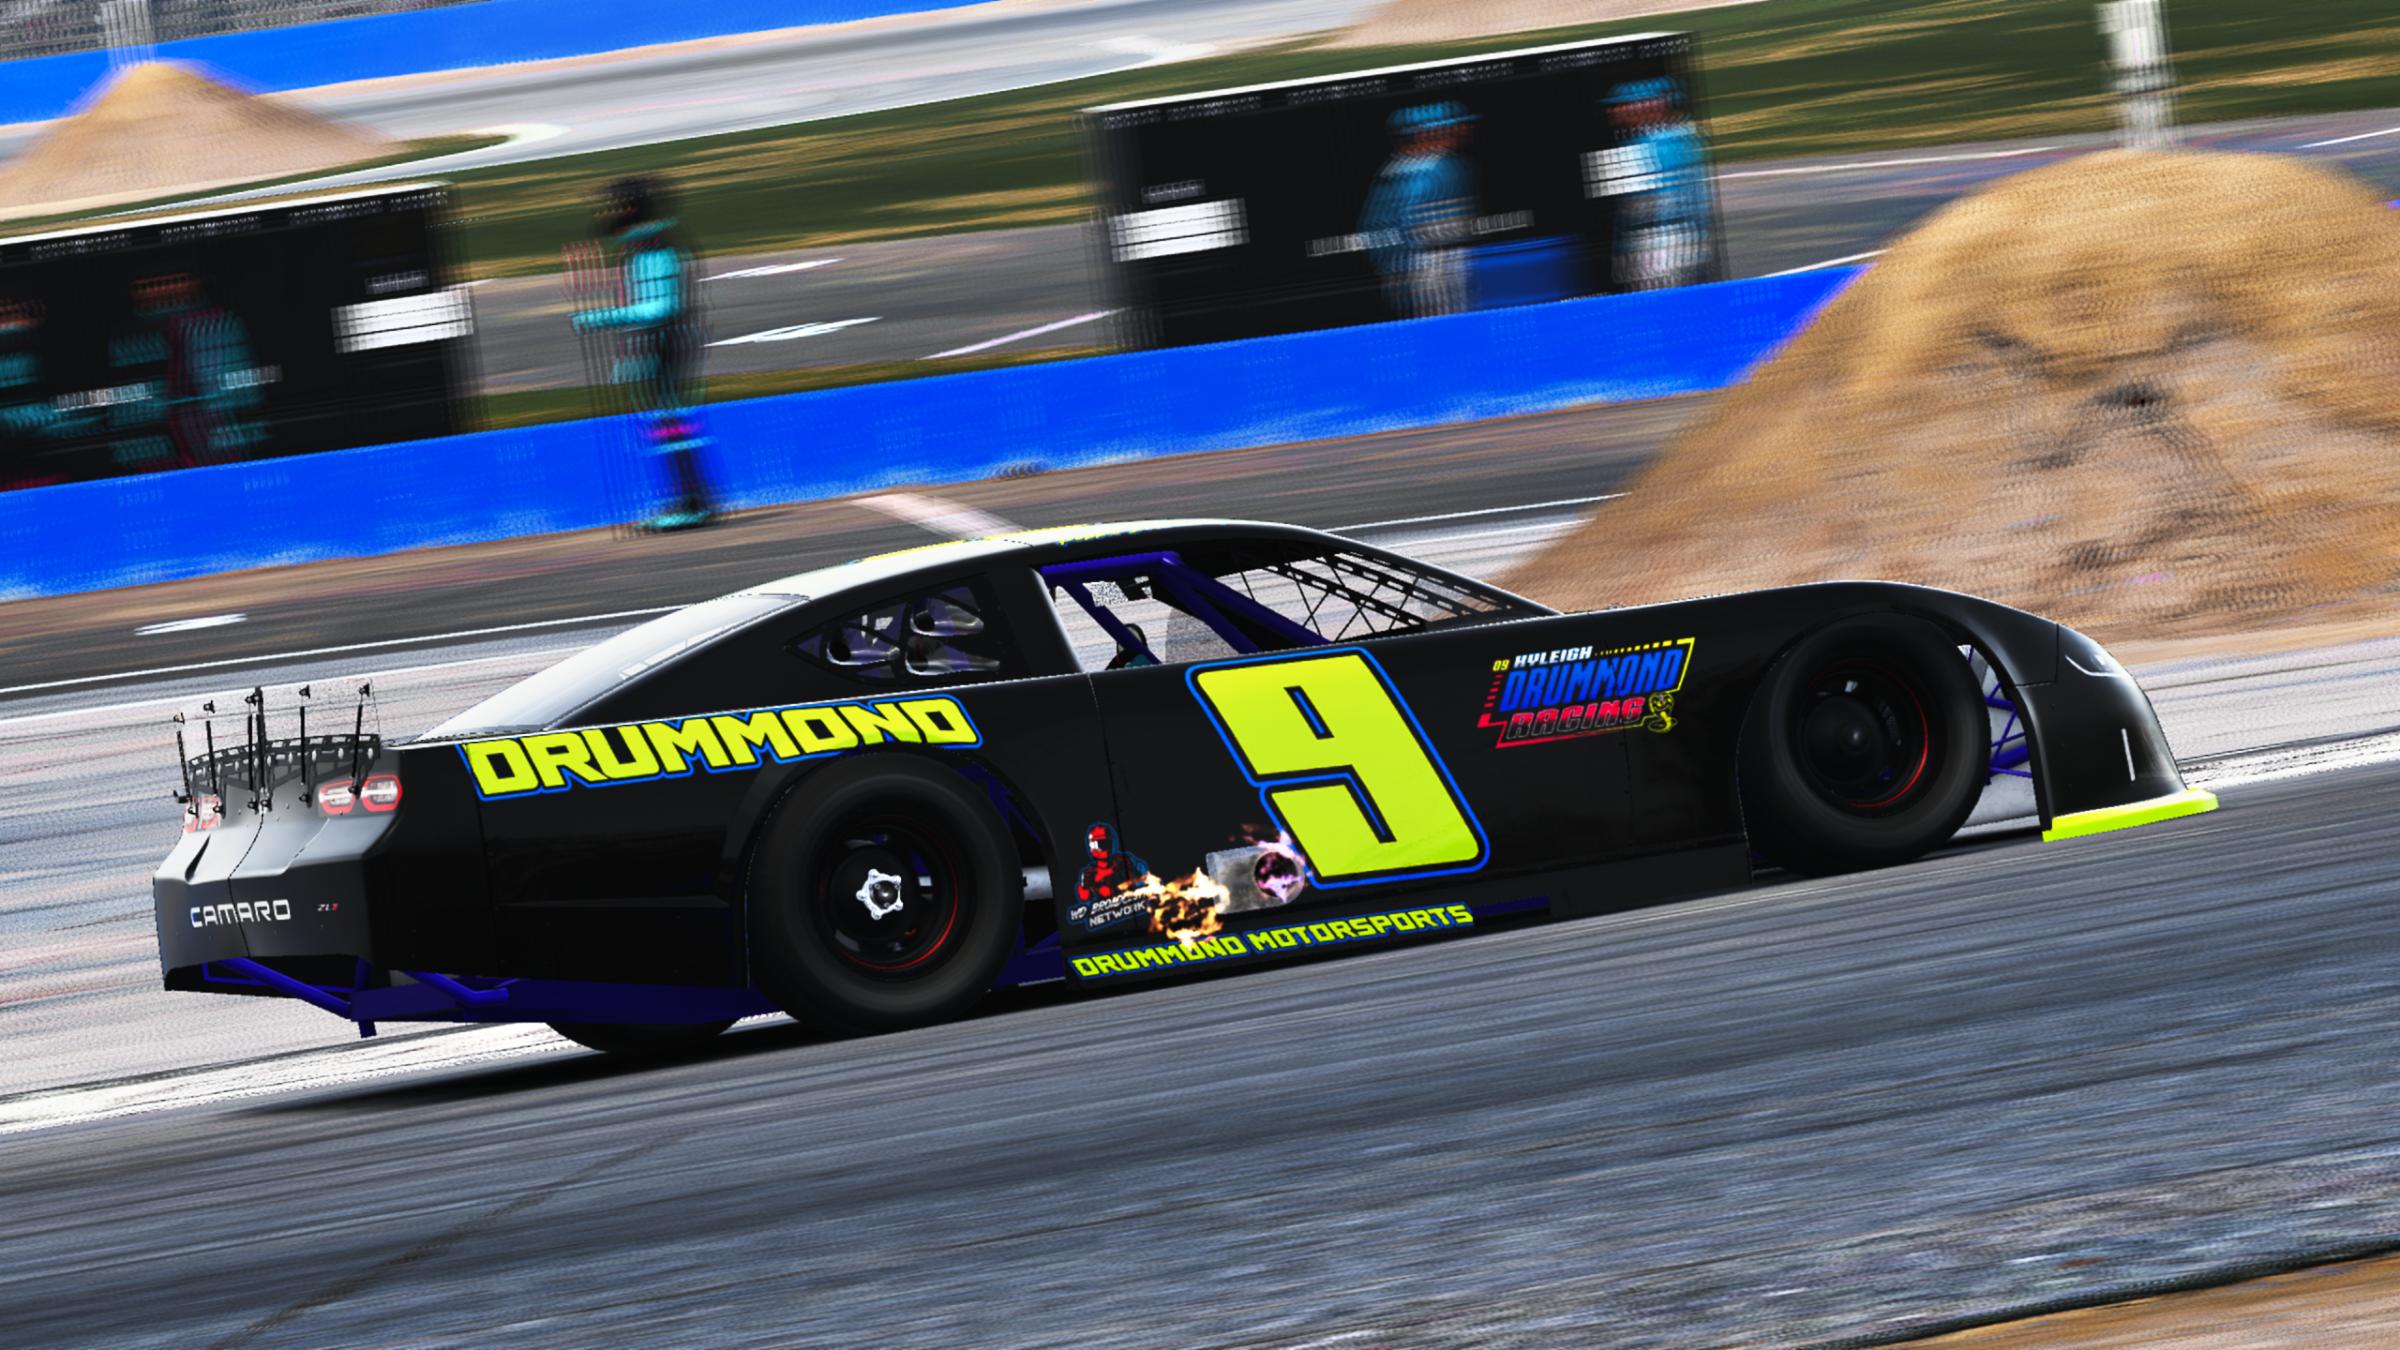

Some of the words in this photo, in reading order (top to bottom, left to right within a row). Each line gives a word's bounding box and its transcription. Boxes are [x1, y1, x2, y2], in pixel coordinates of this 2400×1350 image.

[1493, 659, 1511, 672] 09
[1499, 648, 1684, 712] DRUMMOND
[1505, 696, 1647, 740] RACING
[463, 697, 978, 796] DRUMMOND
[1195, 653, 1481, 878] 9
[190, 899, 291, 928] CAMARO
[1071, 935, 1248, 977] DRUMMOND
[1251, 904, 1474, 952] MOTORSPORTS
[1089, 901, 1146, 927] NETWORK
